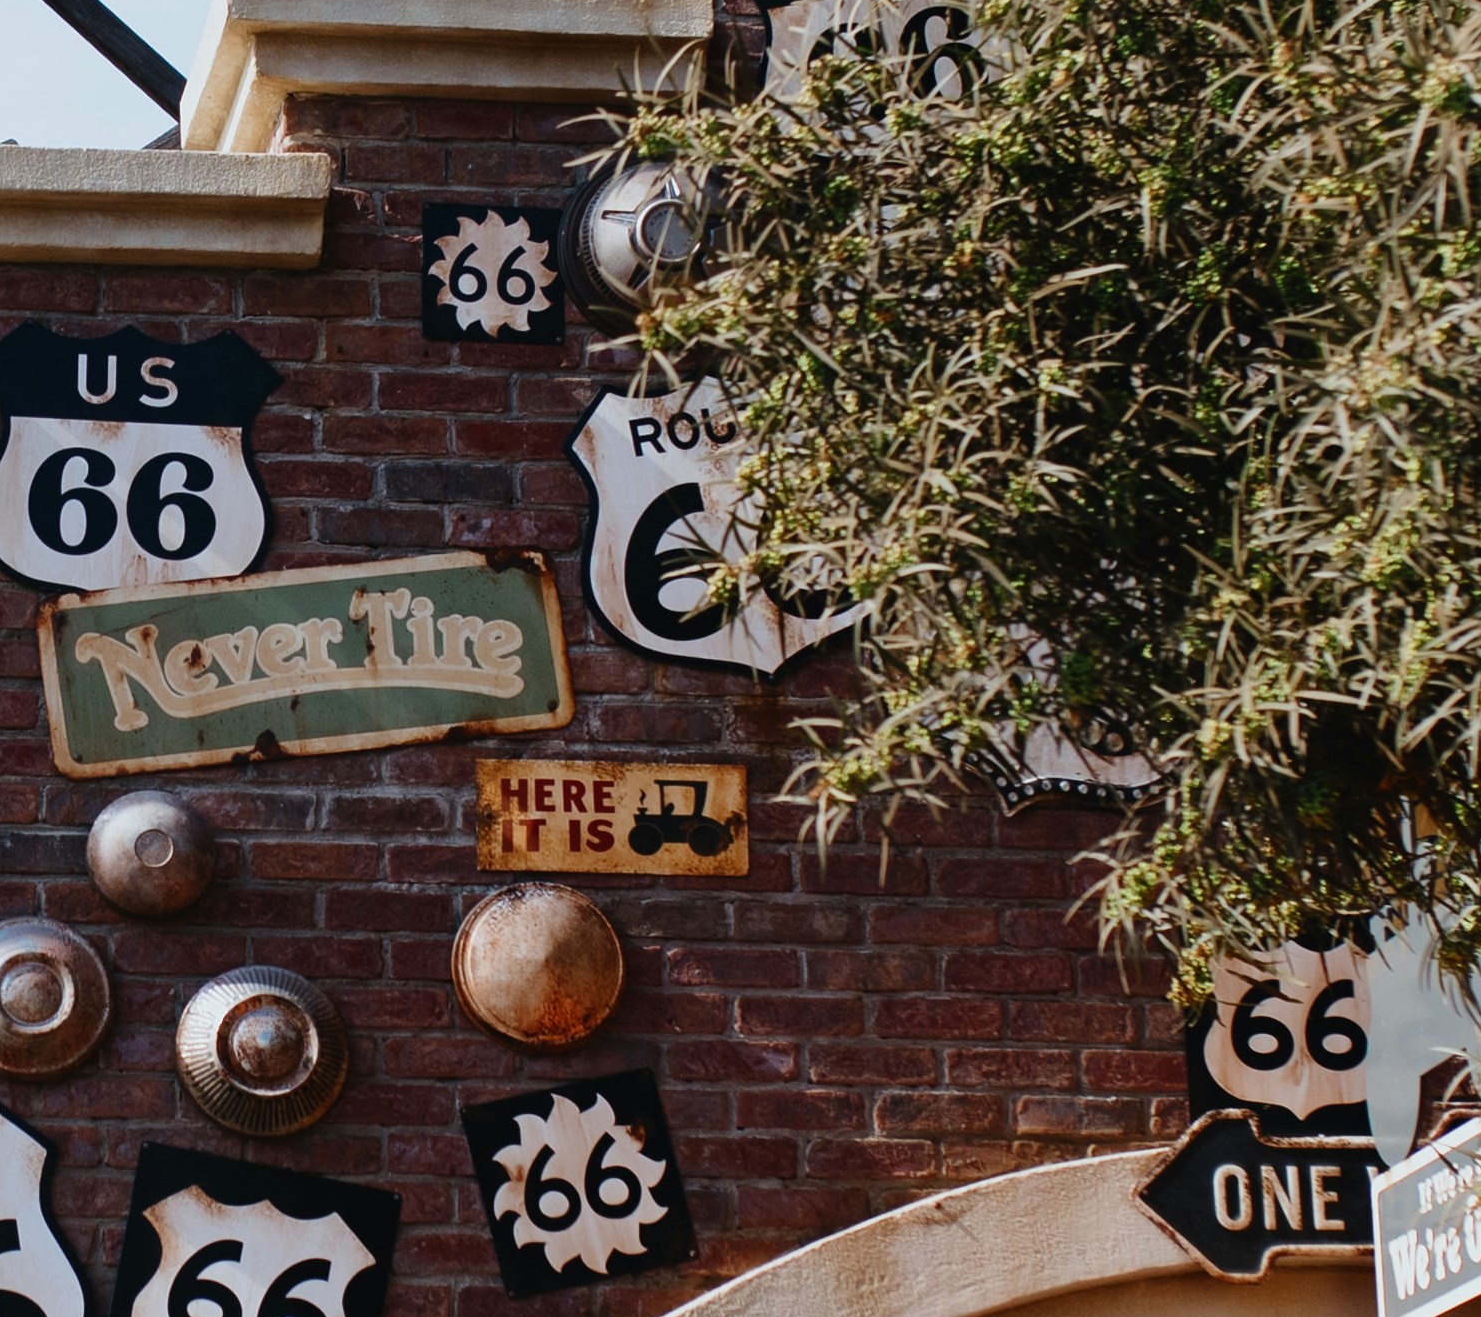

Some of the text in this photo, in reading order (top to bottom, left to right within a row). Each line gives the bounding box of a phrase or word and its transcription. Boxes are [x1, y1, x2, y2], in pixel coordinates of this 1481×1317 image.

[450, 245, 535, 303] 66
[77, 352, 179, 409] US
[629, 399, 747, 458] ROU
[27, 446, 218, 561] 66
[75, 586, 525, 731] Never Tire
[500, 776, 616, 817] HERE
[500, 819, 616, 853] IT IS
[1231, 978, 1368, 1072] 66
[522, 1130, 641, 1234] 66
[1213, 1163, 1346, 1232] ONE
[1389, 1228, 1463, 1301] We're
